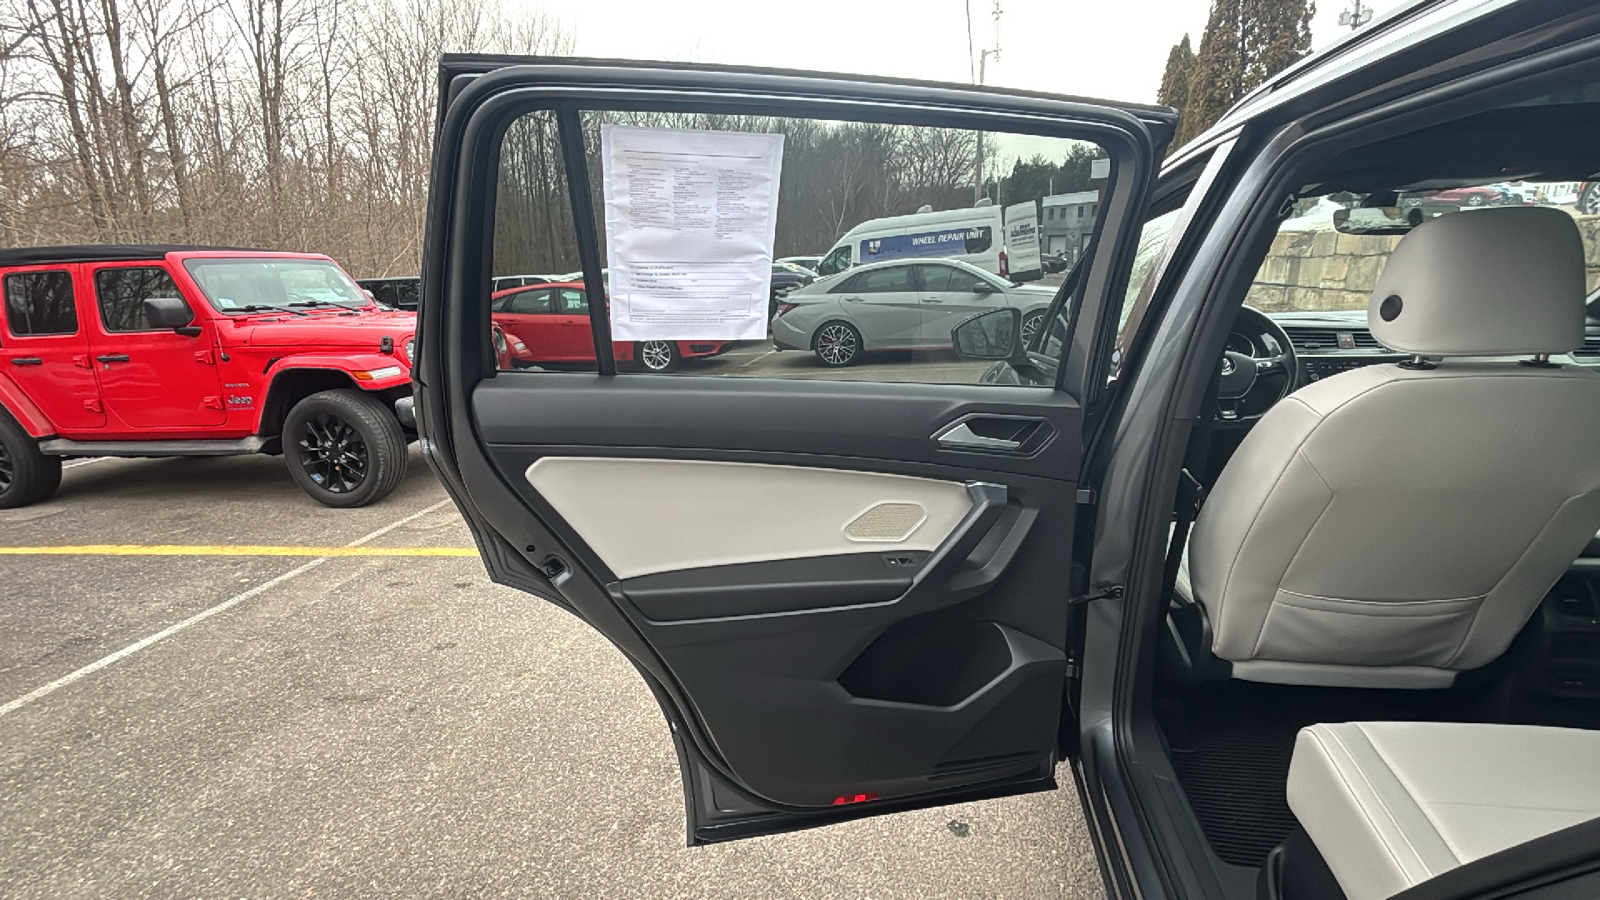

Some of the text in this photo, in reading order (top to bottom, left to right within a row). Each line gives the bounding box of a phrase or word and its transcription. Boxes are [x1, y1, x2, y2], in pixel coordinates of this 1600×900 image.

[912, 229, 985, 246] WHEEL REPAIR UNIT
[227, 394, 253, 405] Jeep
